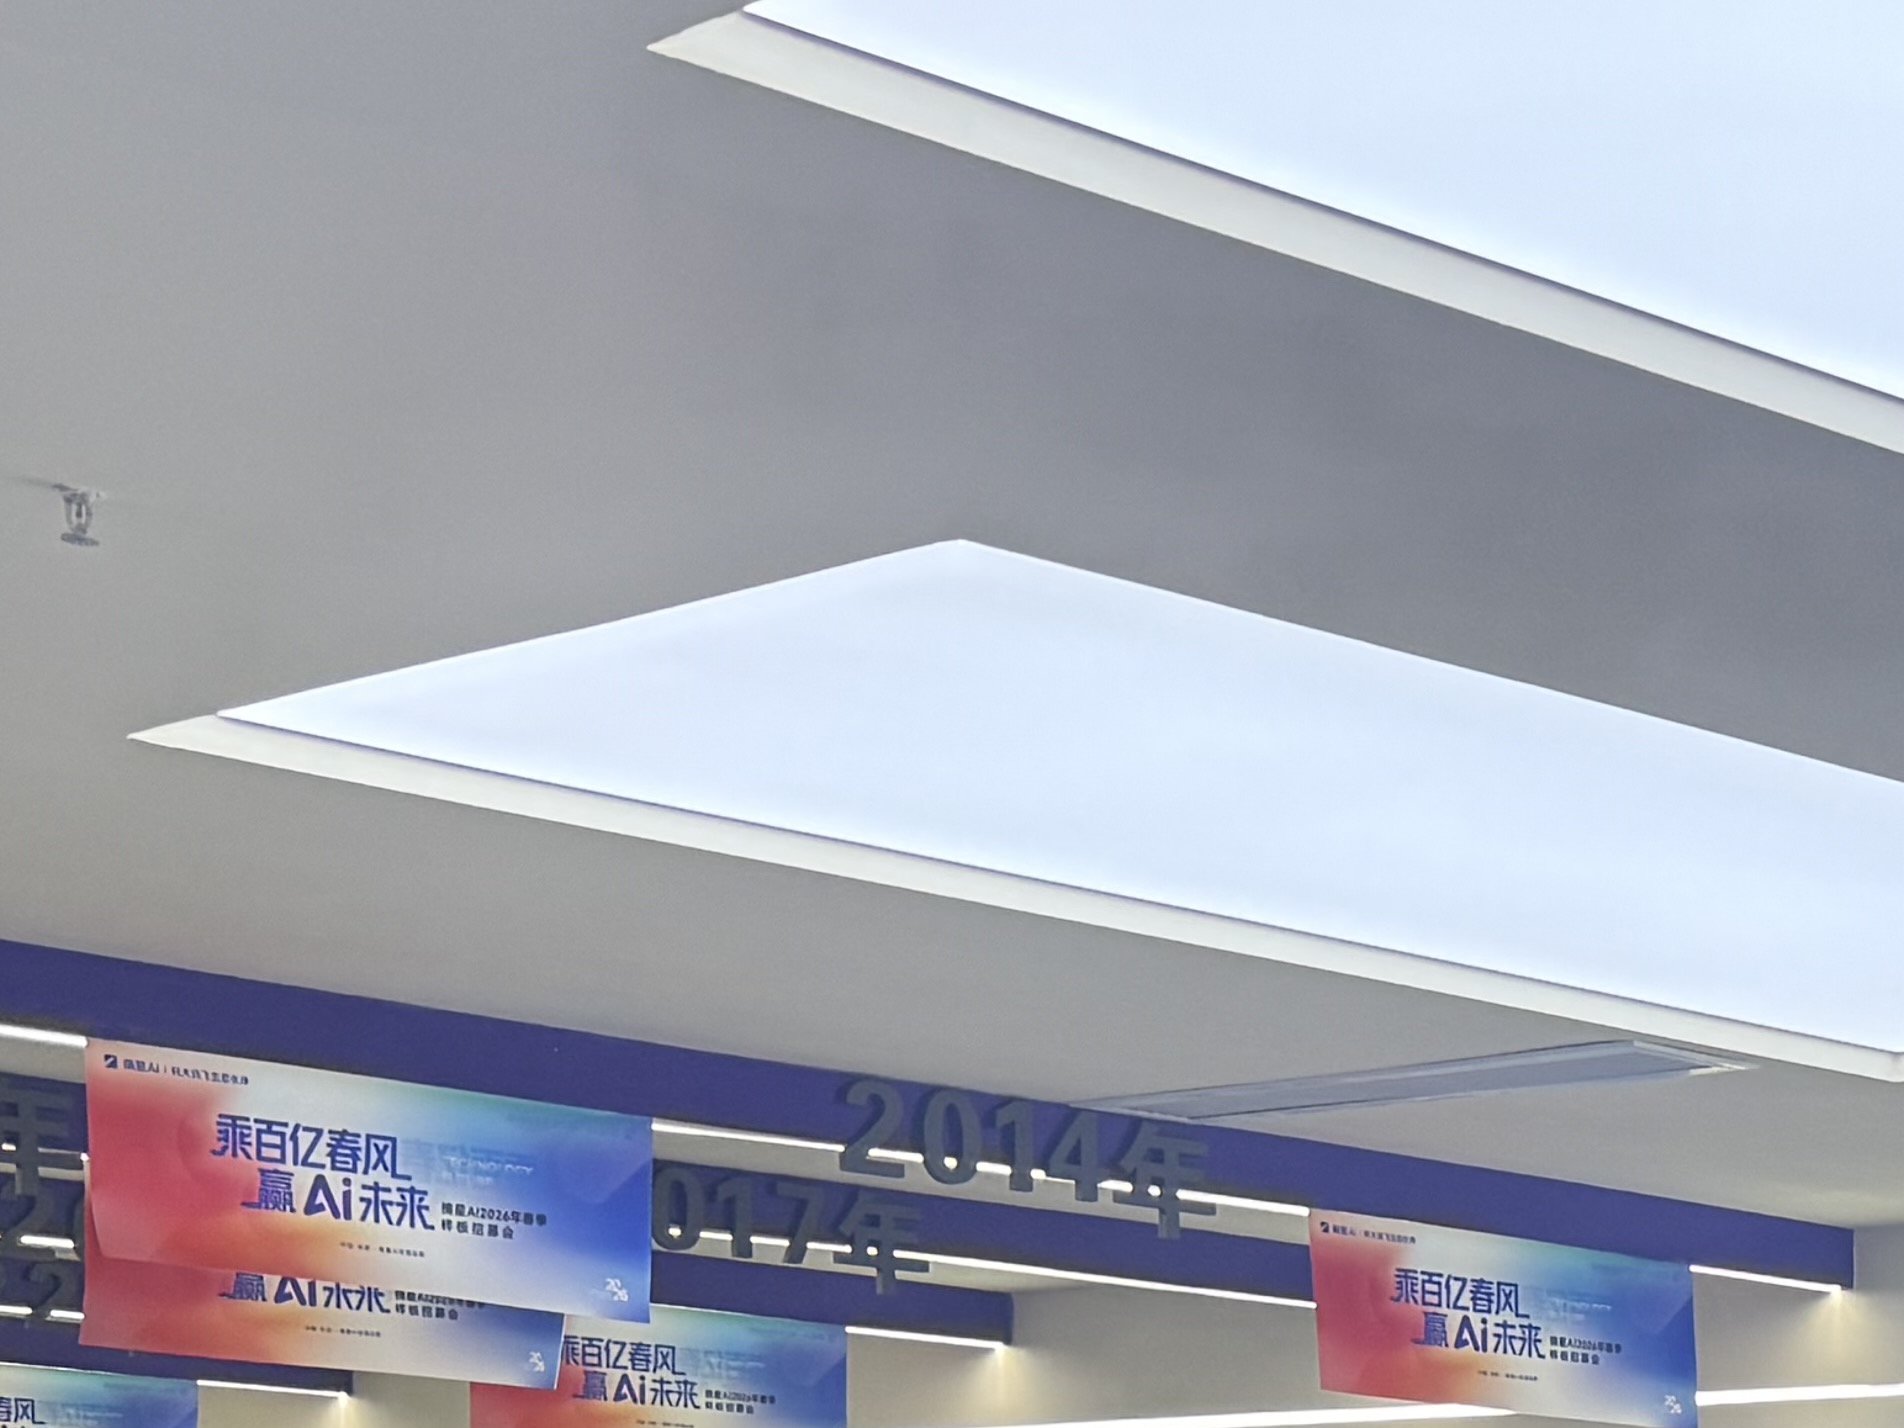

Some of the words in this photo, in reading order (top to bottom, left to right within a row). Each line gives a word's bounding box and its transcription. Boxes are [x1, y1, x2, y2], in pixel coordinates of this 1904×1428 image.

[210, 1112, 413, 1182] 乘百亿春风
[839, 1080, 1215, 1239] 2014年
[1390, 1267, 1531, 1319] 乘百亿春风
